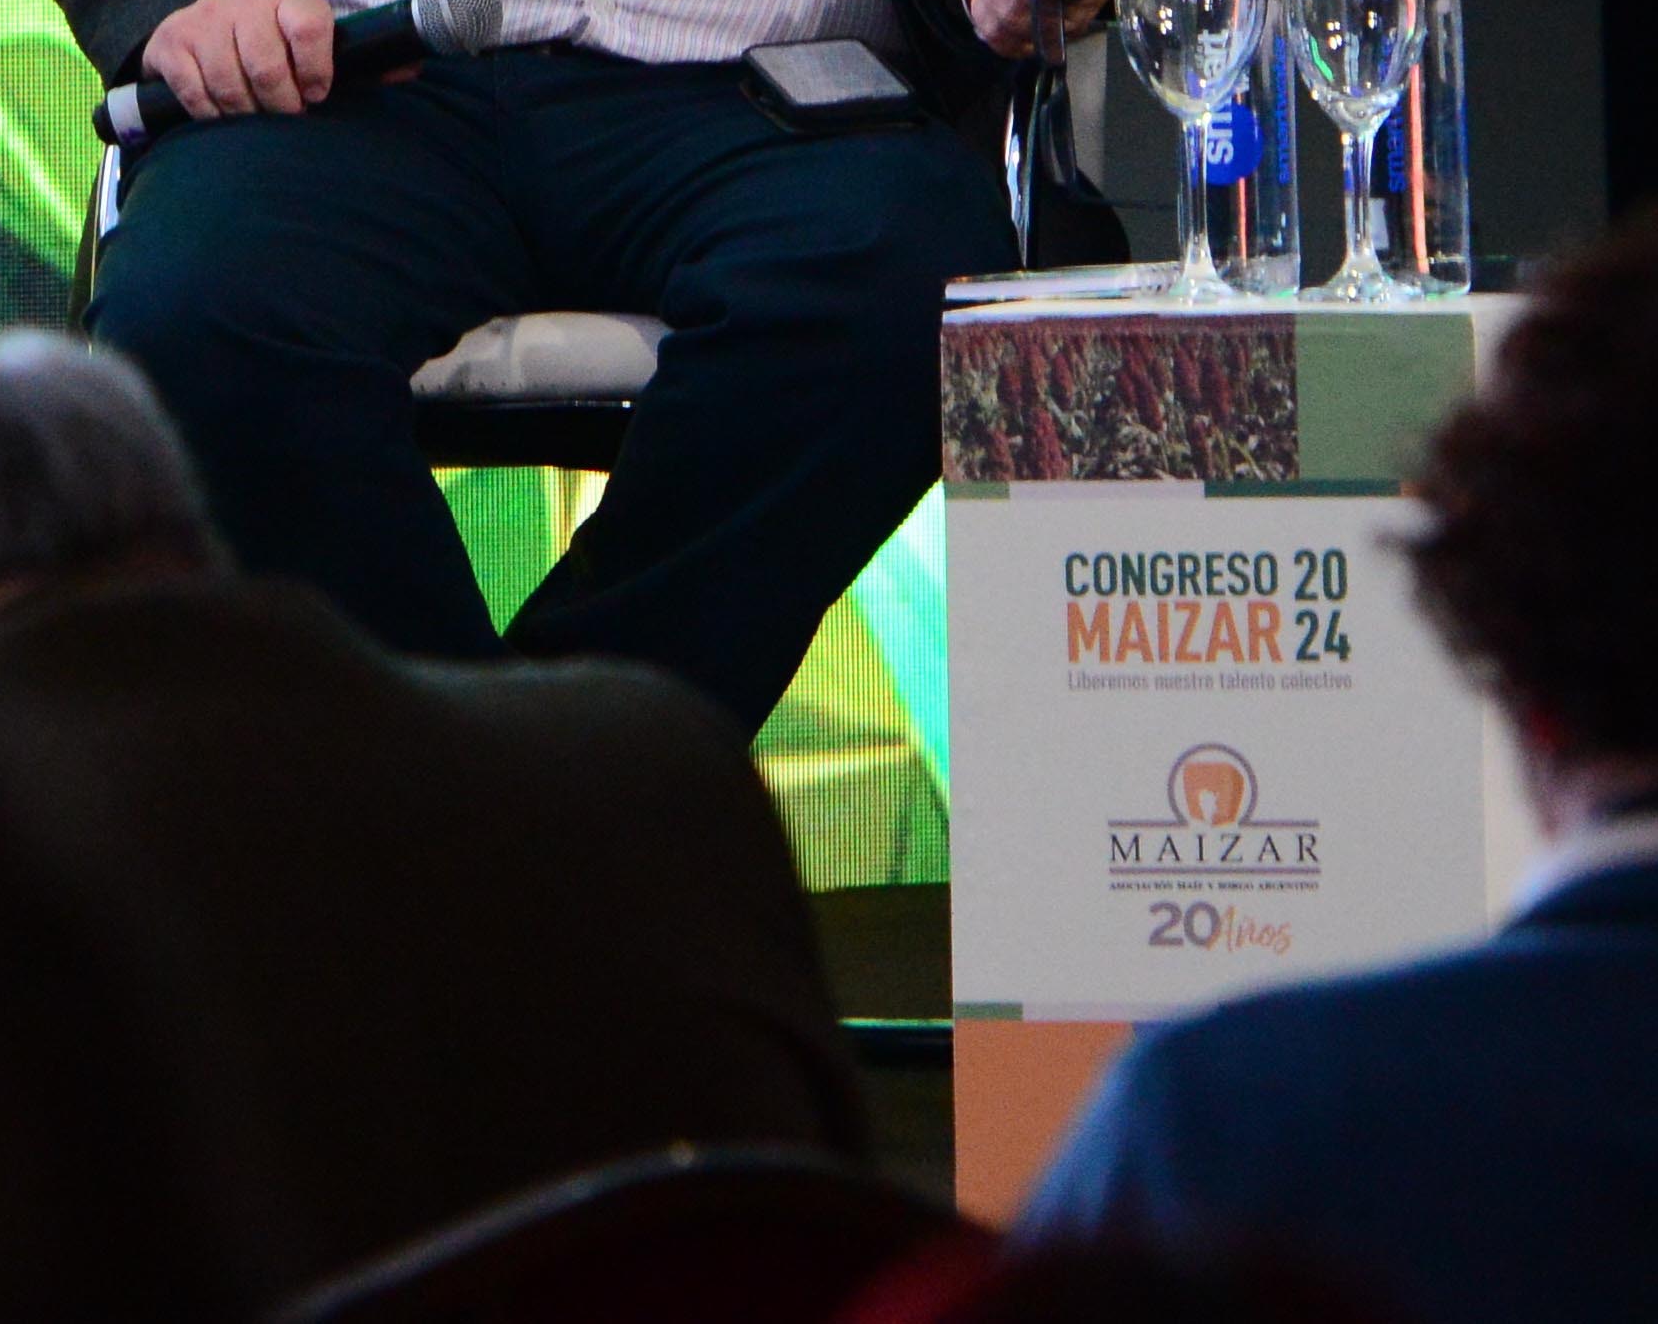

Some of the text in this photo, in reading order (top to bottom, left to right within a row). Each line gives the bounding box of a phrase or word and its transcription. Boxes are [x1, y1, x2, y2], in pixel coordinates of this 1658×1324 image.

[1065, 546, 1348, 602] CONGRESO 20
[1066, 600, 1352, 664] MAIZAR 24
[1068, 669, 1353, 692] Liberemos nuestro talento colectivo
[1109, 833, 1319, 863] MAIZAR
[1148, 900, 1222, 947] 20
